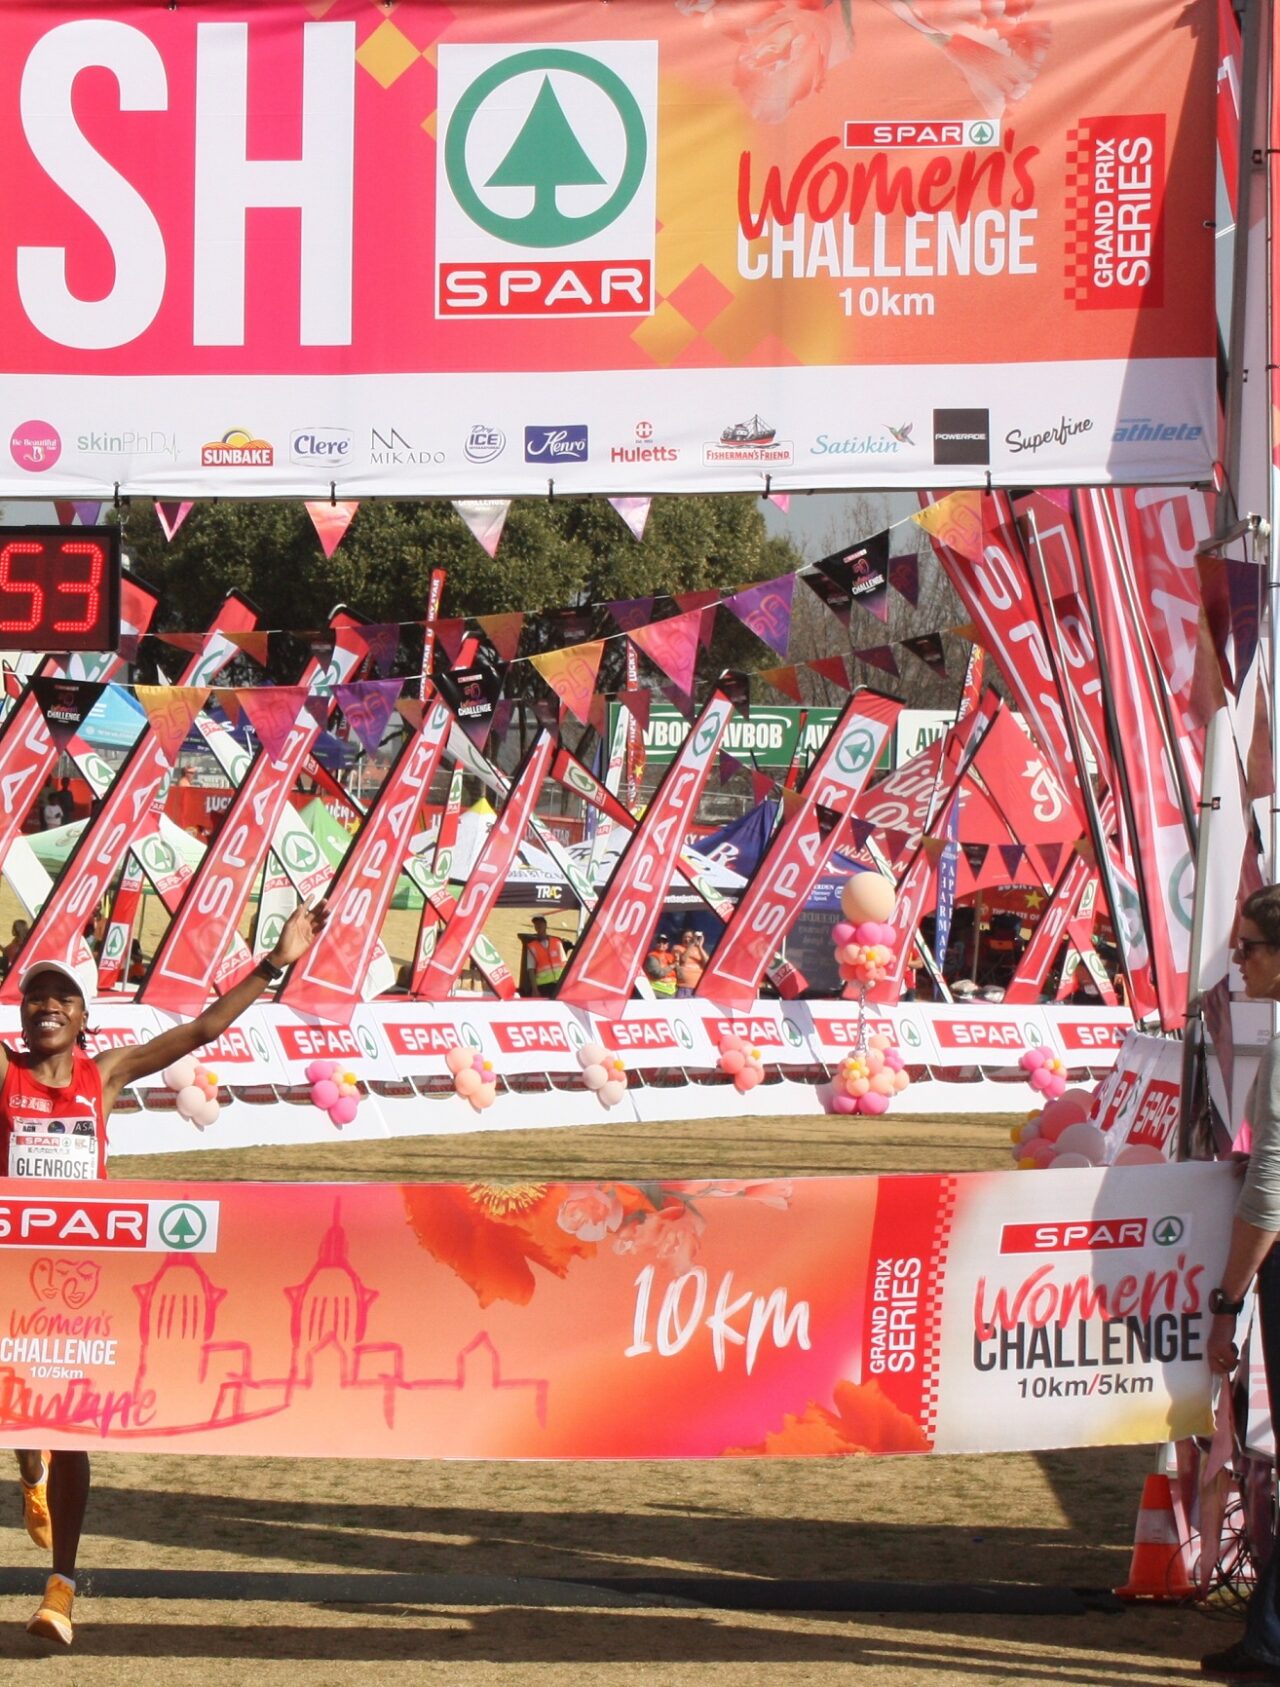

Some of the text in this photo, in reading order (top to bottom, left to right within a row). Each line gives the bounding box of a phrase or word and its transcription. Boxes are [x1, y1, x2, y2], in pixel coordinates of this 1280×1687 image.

[872, 125, 962, 146] SPAR
[738, 130, 1039, 241] Women's
[1094, 137, 1116, 289] GRAND PRIX
[1117, 136, 1152, 288] SERIES
[737, 207, 1038, 282] CHALLENGE
[445, 268, 644, 308] SPAR
[838, 288, 937, 318] 10km
[470, 433, 498, 445] ICE
[527, 430, 586, 457] Henro
[811, 433, 899, 455] Satiskin
[935, 433, 986, 441] POWERADE
[1005, 416, 1094, 453] Superfine
[1111, 420, 1203, 443] athlete
[204, 447, 271, 465] SUNBAKE
[294, 434, 349, 455] Clere
[611, 446, 678, 463] Huletts
[706, 448, 790, 463] FISHERMAN'S FRIEND
[370, 452, 446, 464] MIKADO
[851, 574, 885, 596] CHALLENGE
[46, 711, 81, 722] CHALLENGE
[458, 703, 492, 717] CHALLENGE
[340, 742, 435, 928] SPAR
[615, 771, 695, 935] SPAR
[535, 885, 563, 899] TRAC
[216, 948, 251, 979] SPAR
[295, 1030, 357, 1056] SPAR
[401, 1027, 461, 1051] SPAR
[506, 1026, 564, 1048] SPAR
[614, 1022, 674, 1045] SPAR
[719, 1020, 778, 1042] SPAR
[955, 1023, 1022, 1045] SPAR
[1134, 1090, 1181, 1140] SPAR
[24, 1137, 59, 1146] SPAR
[16, 1157, 89, 1179] GLENROSE
[1035, 1222, 1144, 1248] SPAR
[974, 1253, 1205, 1342] Women's
[10, 1306, 114, 1339] Women's
[624, 1264, 812, 1376] 10km
[870, 1257, 893, 1374] GRAND PRIX
[888, 1257, 922, 1373] SERIES
[0, 1336, 118, 1366] CHALLENGE
[973, 1312, 1204, 1371] CHALLENGE
[29, 1366, 84, 1380] 10/5km
[1017, 1373, 1154, 1400] 10km/5km
